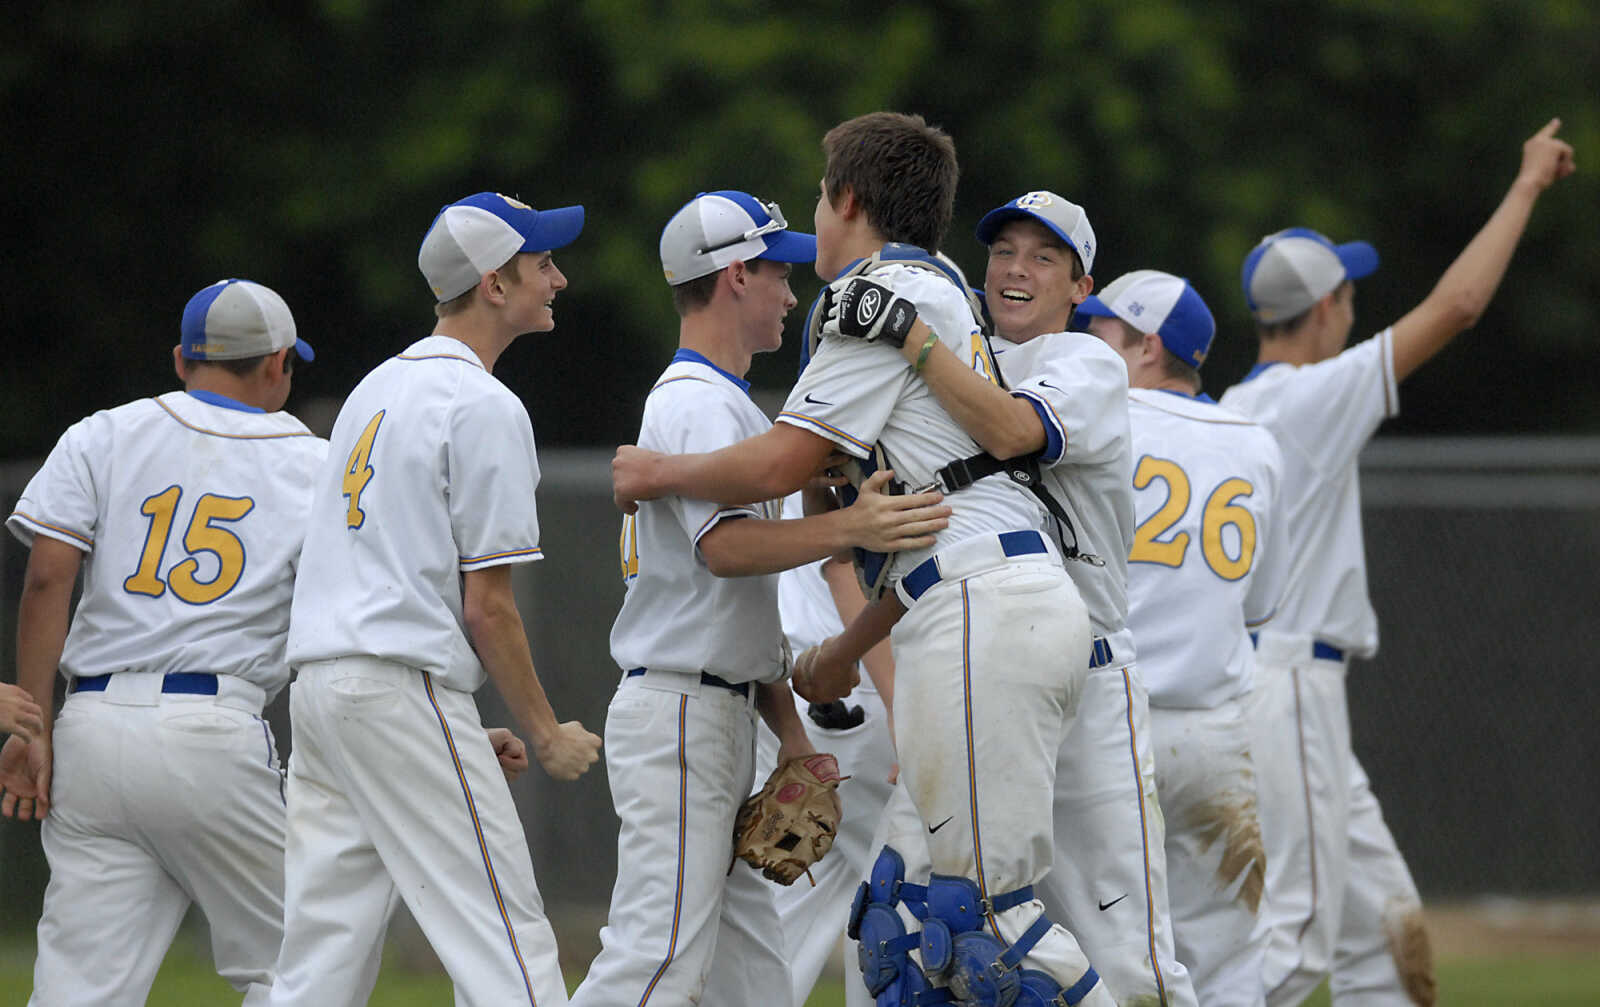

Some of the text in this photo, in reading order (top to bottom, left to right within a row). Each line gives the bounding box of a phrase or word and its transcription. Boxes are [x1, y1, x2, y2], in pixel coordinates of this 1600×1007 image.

[342, 409, 386, 530] 4
[1127, 454, 1257, 582] 26
[123, 484, 256, 606] 15
